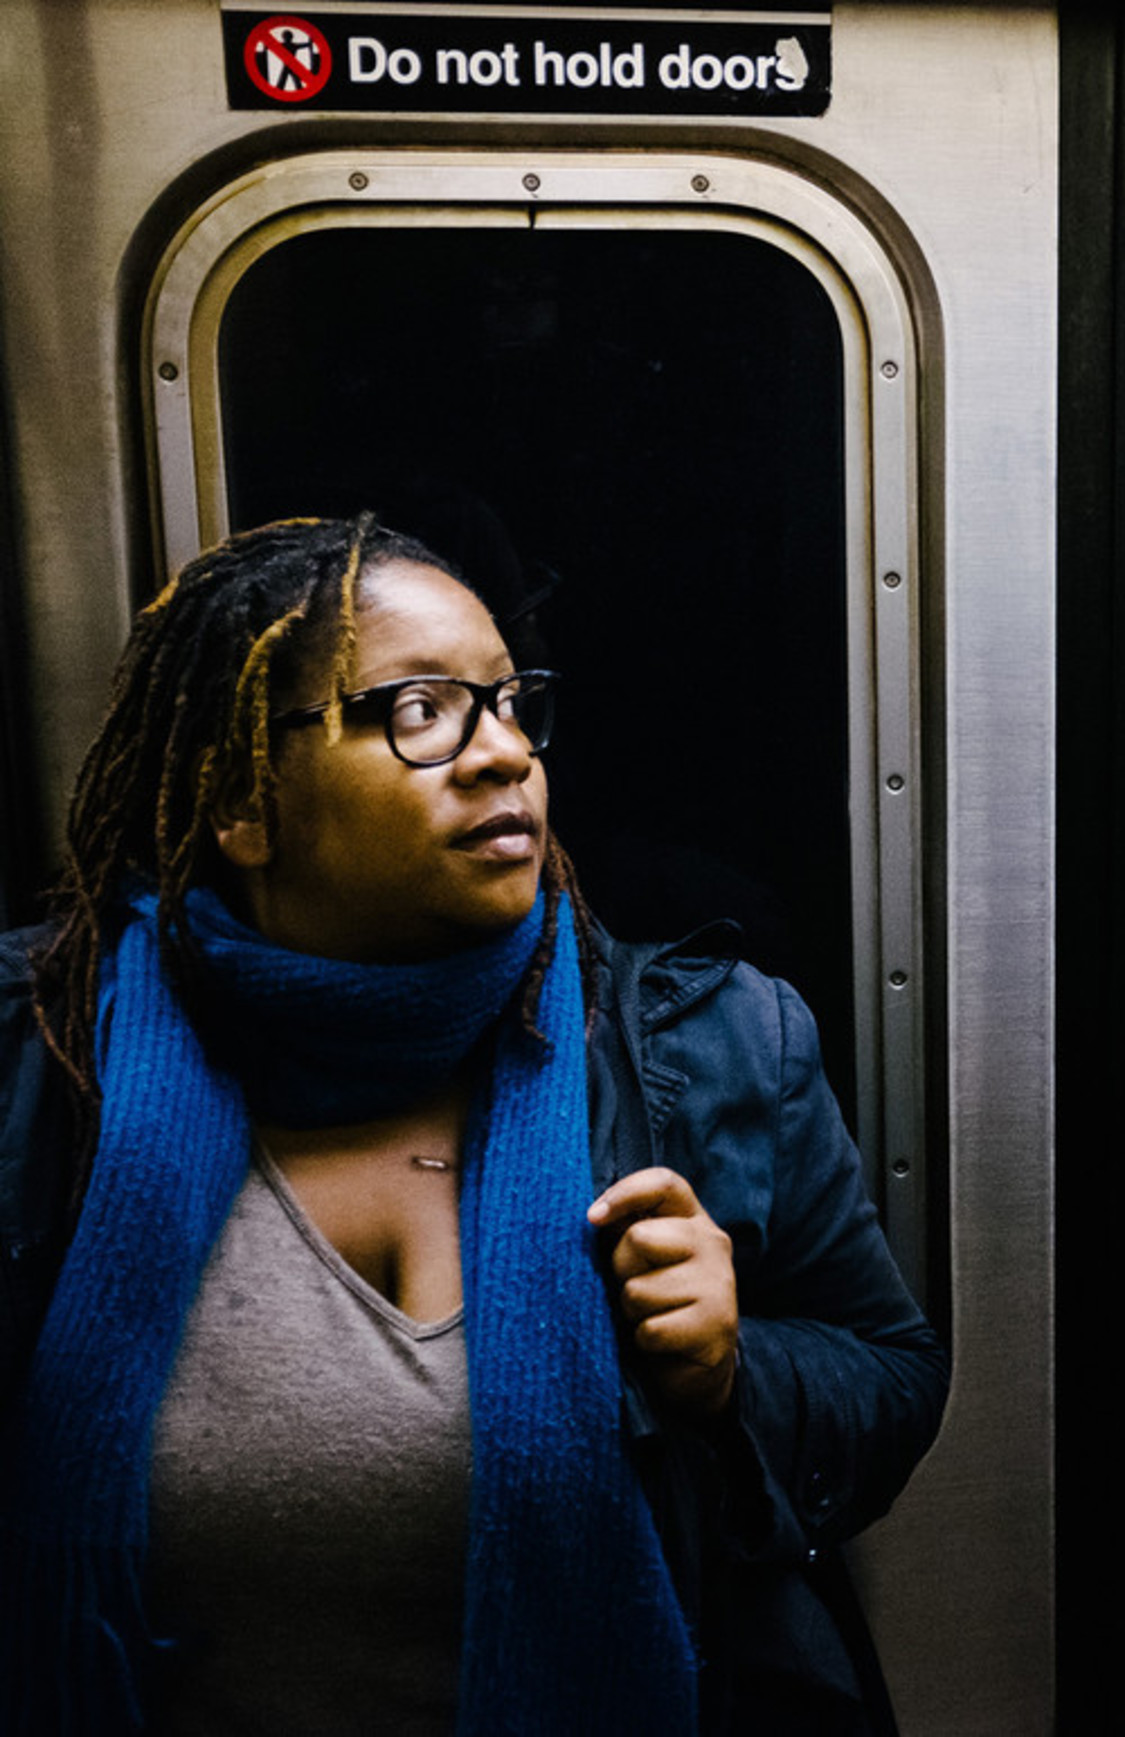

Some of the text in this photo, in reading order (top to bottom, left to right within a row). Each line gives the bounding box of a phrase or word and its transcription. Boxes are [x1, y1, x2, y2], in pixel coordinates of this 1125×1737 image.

[347, 37, 806, 91] Do not hold doors
